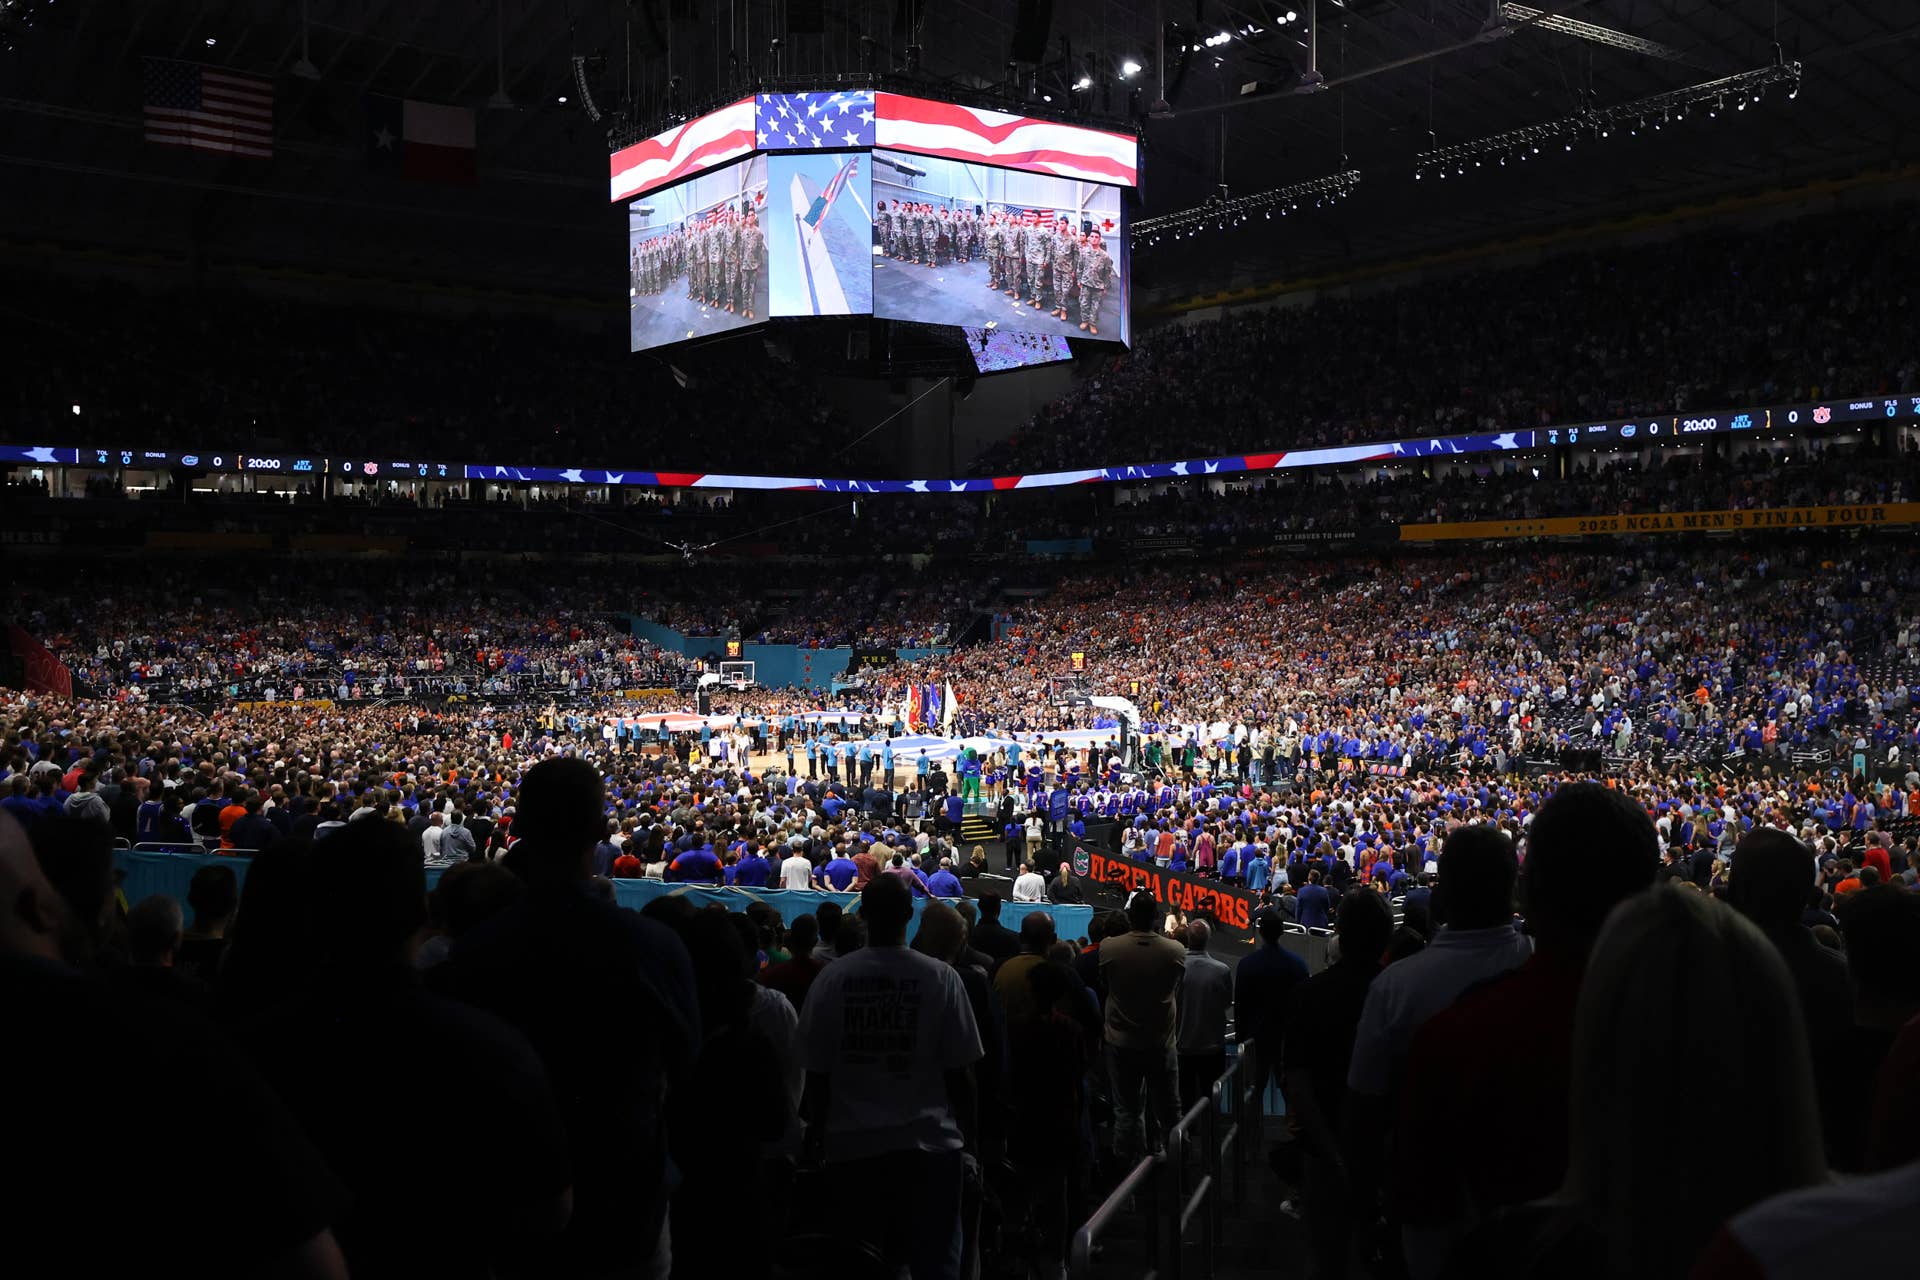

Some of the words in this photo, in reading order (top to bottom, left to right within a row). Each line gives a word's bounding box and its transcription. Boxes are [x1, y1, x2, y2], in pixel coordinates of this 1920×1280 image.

[1849, 402, 1873, 411] BONUS
[1788, 410, 1798, 423] 0
[1886, 406, 1896, 418] 0
[1649, 422, 1658, 435] 0
[1683, 418, 1717, 432] 20:00
[1549, 435, 1558, 445] 4
[1570, 433, 1577, 443] 0
[98, 455, 107, 464] 4
[122, 455, 131, 464] 0
[212, 457, 222, 467] 0
[248, 459, 281, 469] 20:00
[343, 462, 352, 472] 0
[419, 468, 427, 476] 0
[439, 469, 447, 477] 4
[1578, 519, 1619, 531] 2025
[1626, 515, 1675, 529] NCAA
[1683, 513, 1744, 528] MEN'S
[1752, 510, 1817, 525] FINAL
[1827, 506, 1887, 523] FOUR
[862, 655, 888, 663] THE
